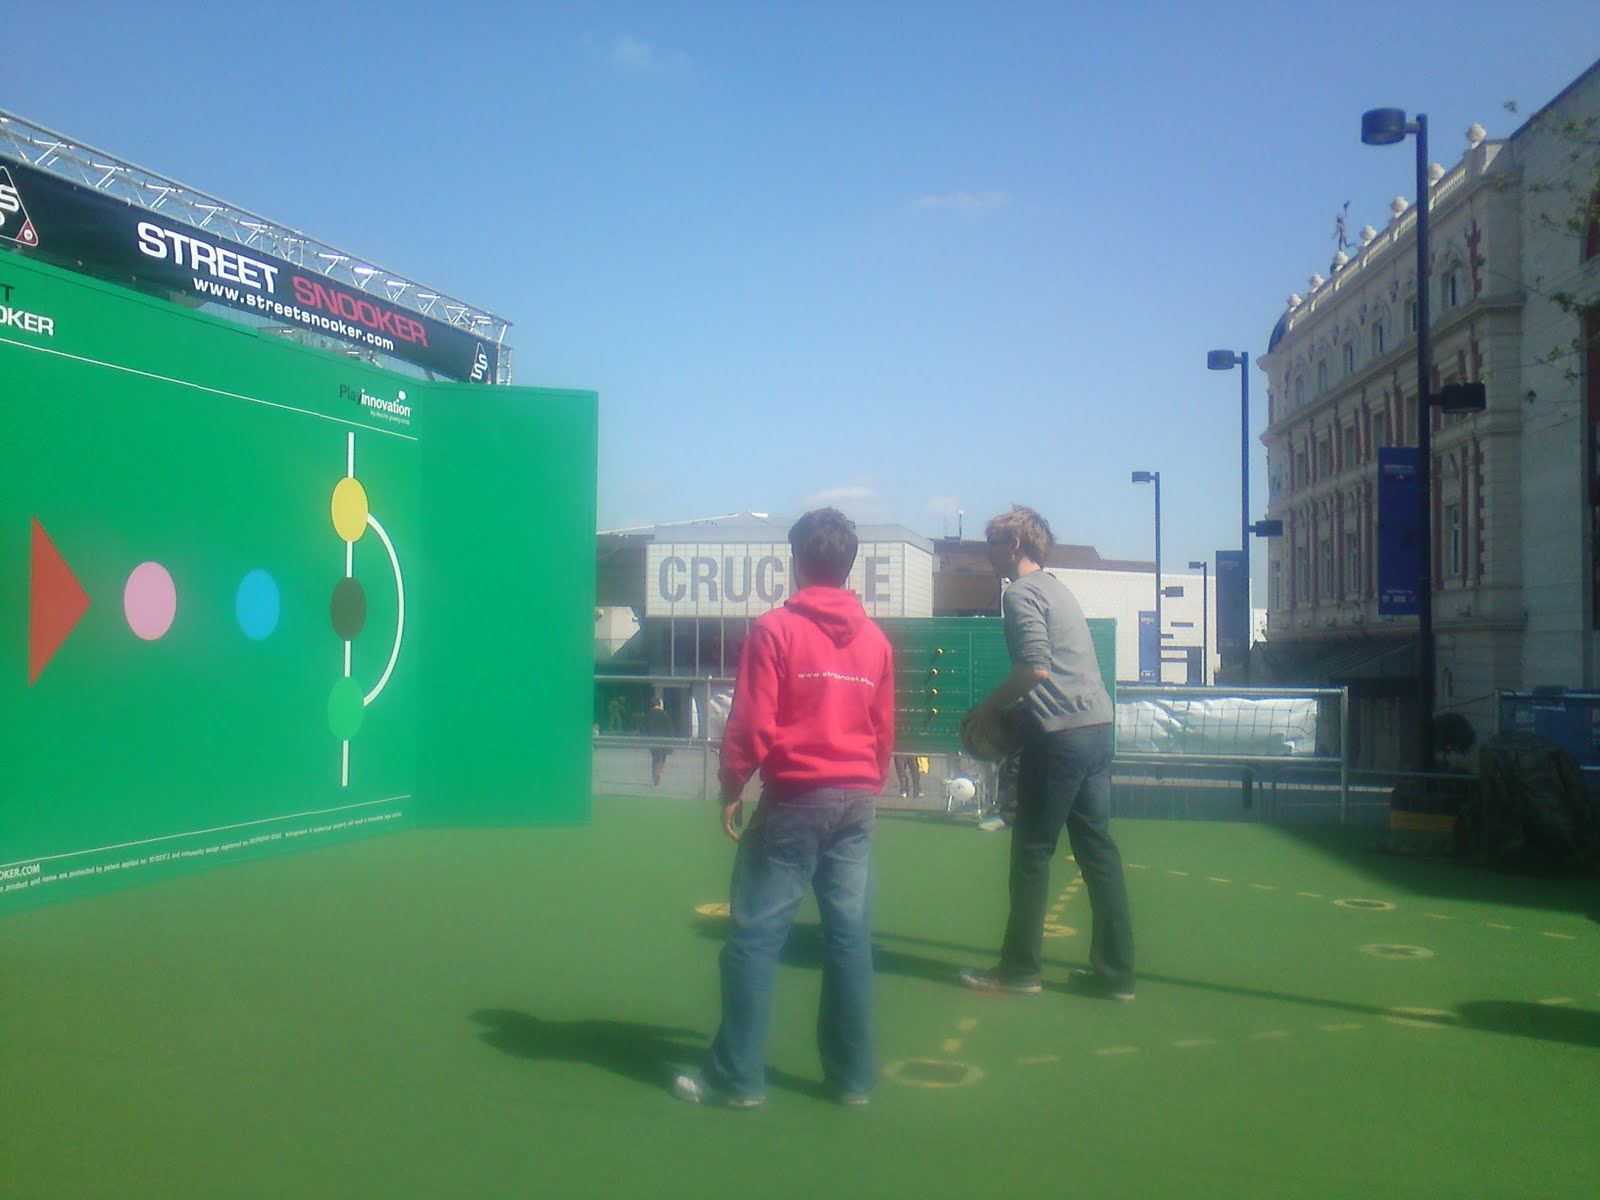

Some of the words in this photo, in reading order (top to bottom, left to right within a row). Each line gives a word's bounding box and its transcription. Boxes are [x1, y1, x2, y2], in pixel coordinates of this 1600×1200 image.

[137, 221, 278, 294] STREET
[292, 275, 429, 348] SNOOKER
[192, 276, 394, 351] www.streetsnooker.com
[658, 555, 890, 603] CRUCE
